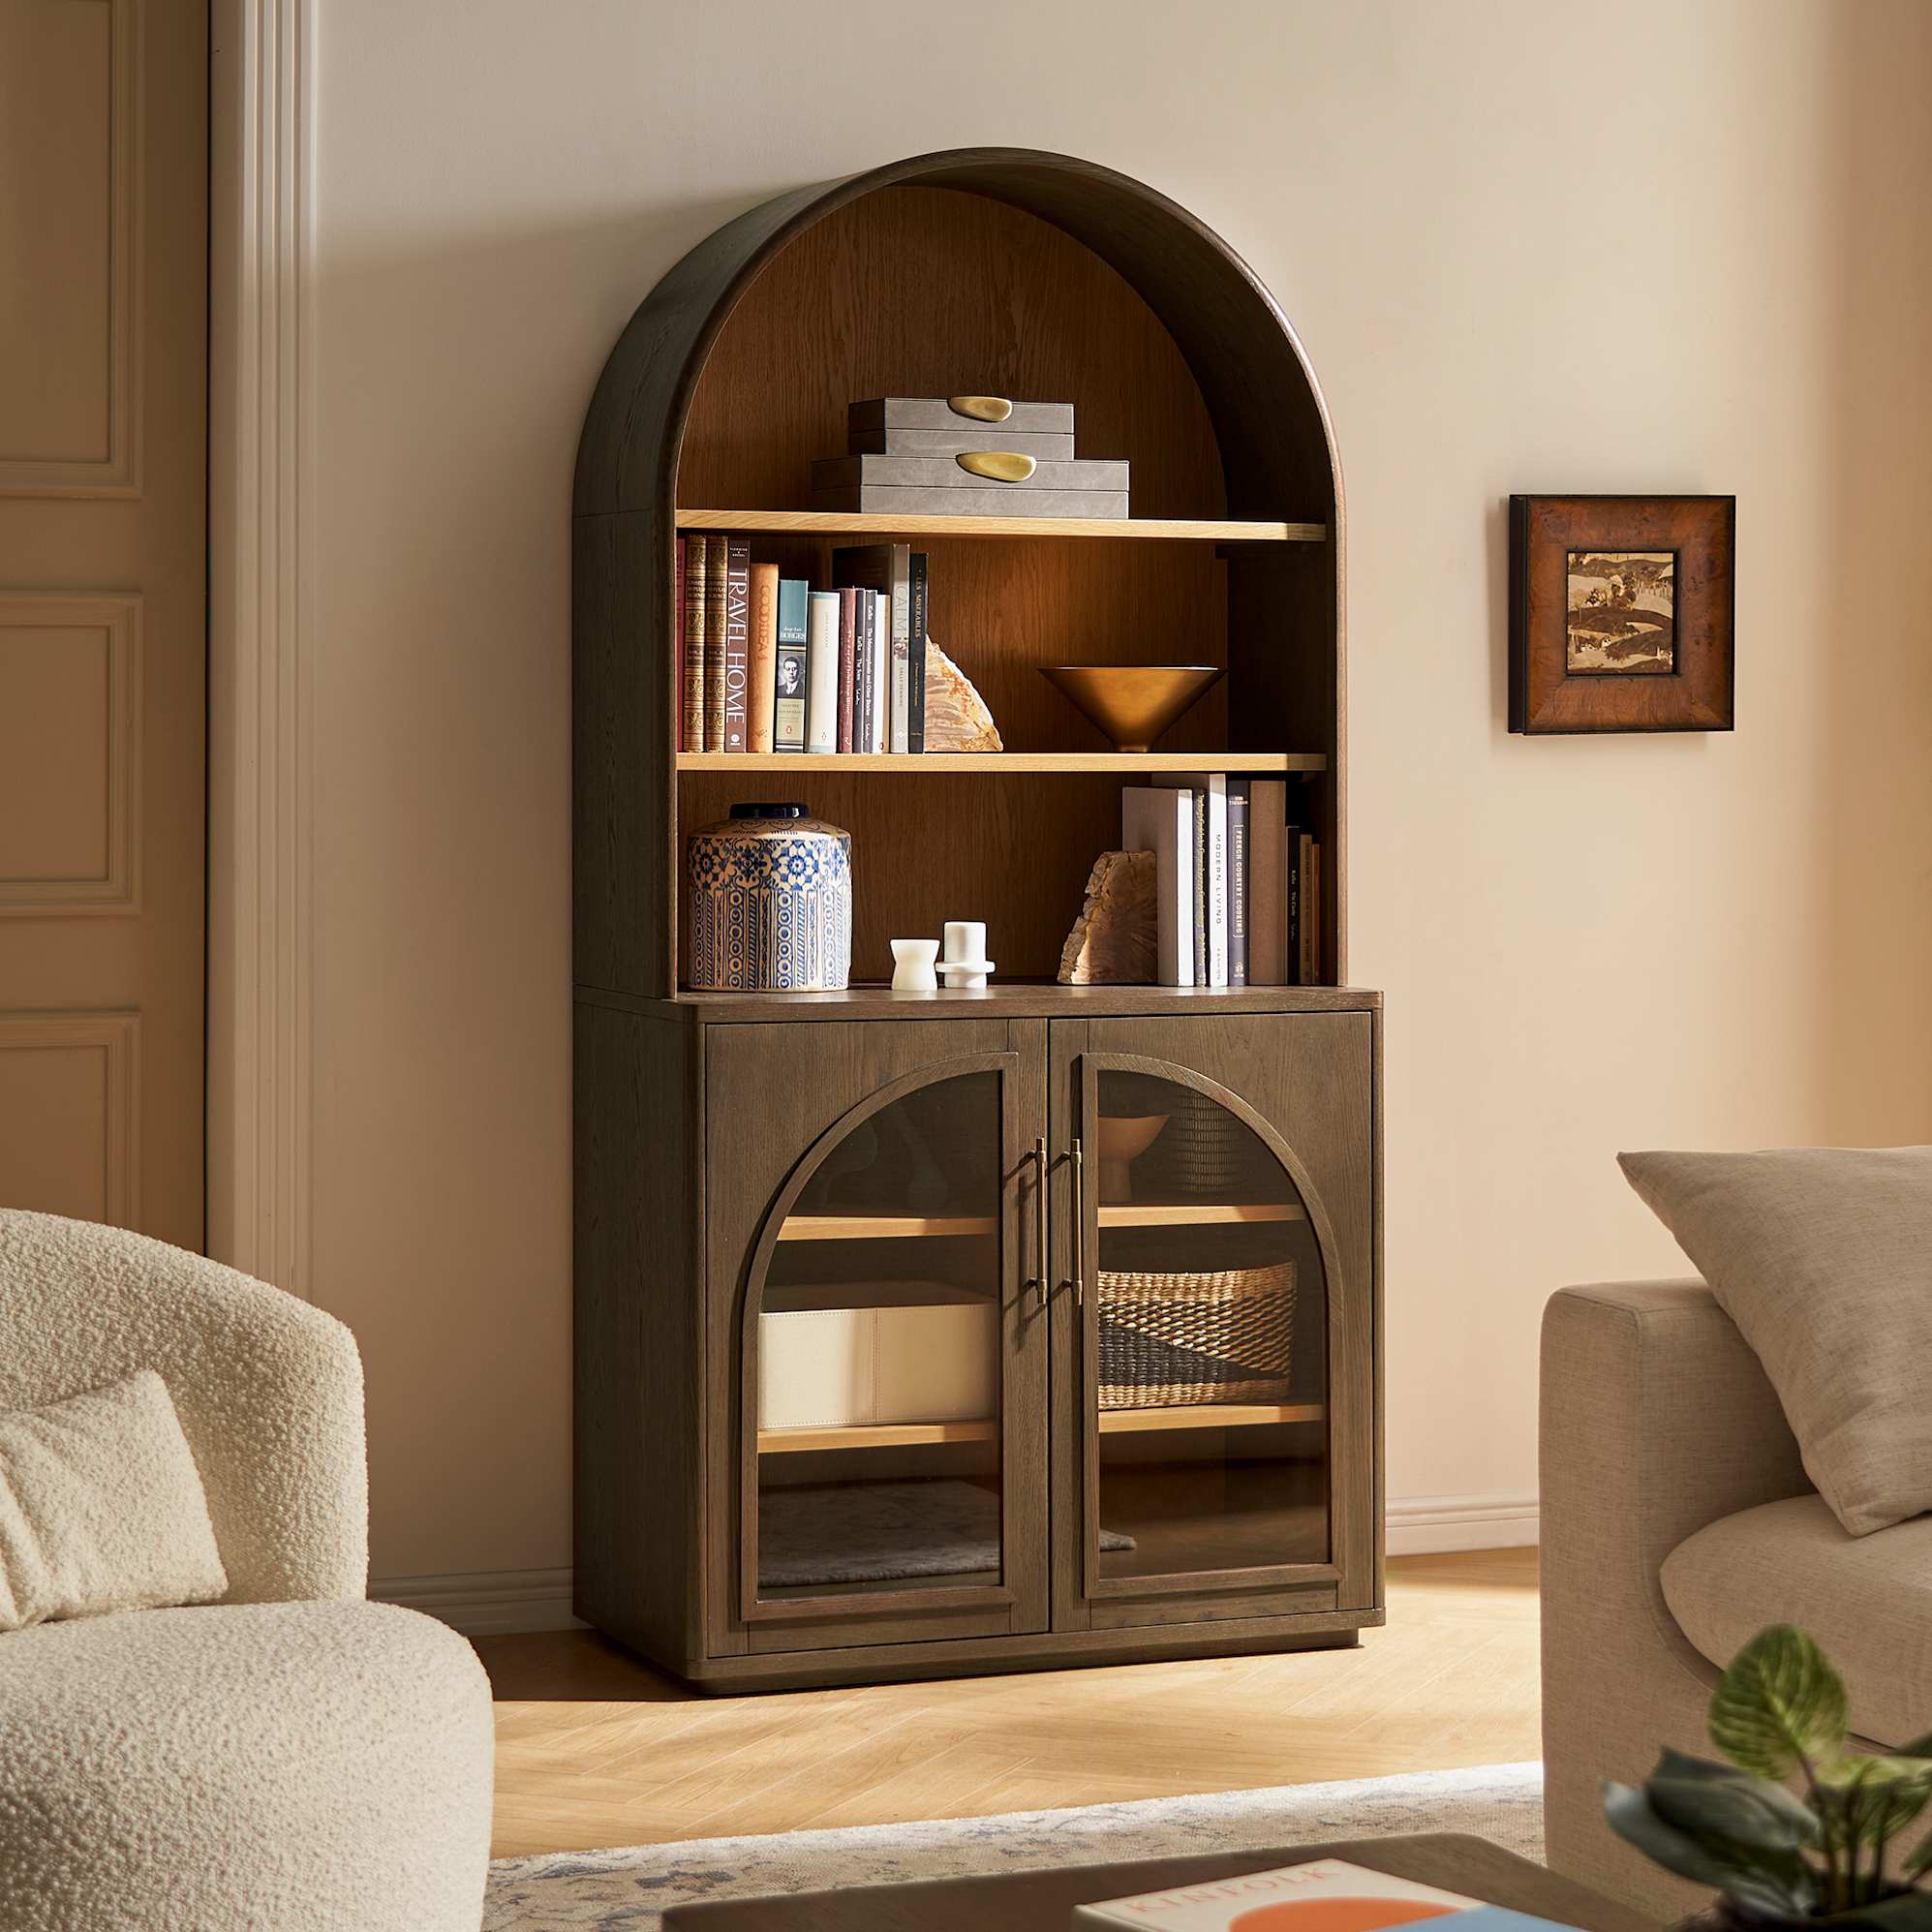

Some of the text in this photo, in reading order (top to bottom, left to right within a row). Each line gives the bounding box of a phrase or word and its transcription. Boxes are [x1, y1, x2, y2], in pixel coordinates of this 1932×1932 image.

[727, 567, 748, 646] TRAVEL
[895, 586, 907, 630] CALM
[726, 654, 746, 723] HOME
[1125, 1866, 1341, 1914] KINFOLK
